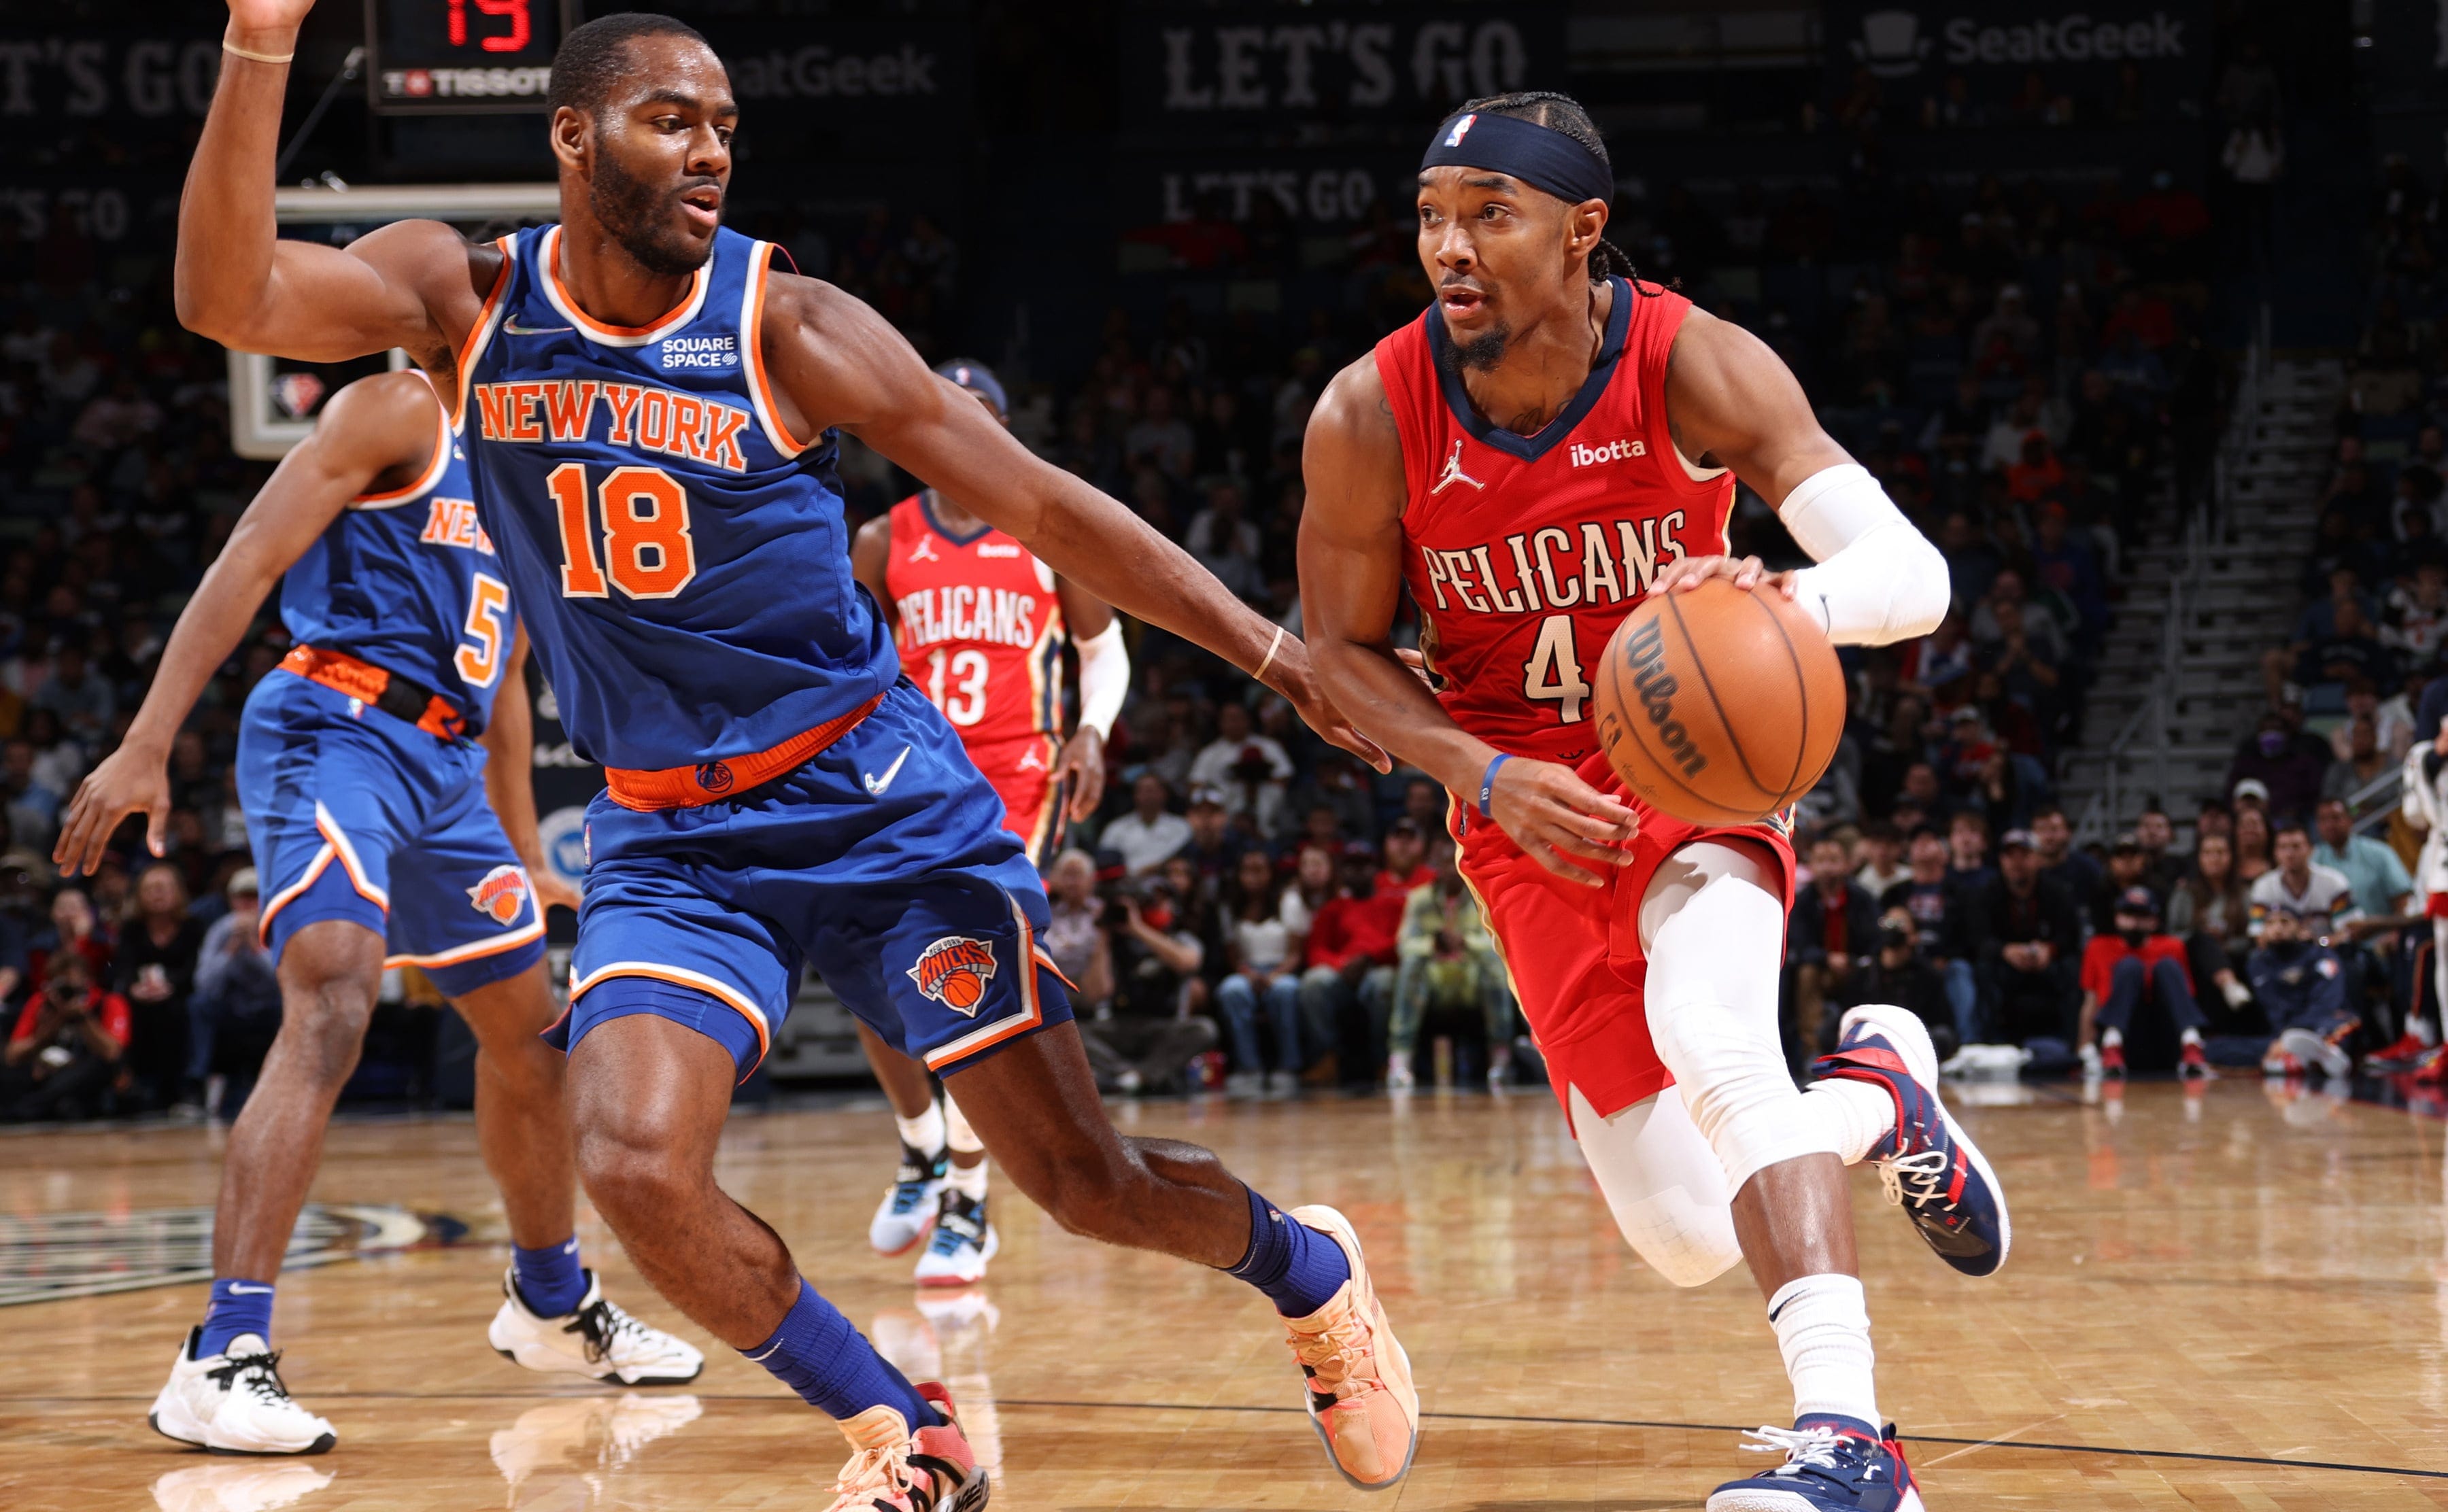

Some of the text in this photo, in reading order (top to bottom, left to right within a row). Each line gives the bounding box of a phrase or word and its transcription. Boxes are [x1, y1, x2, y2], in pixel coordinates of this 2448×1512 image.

[725, 41, 939, 99] atGeek
[1163, 19, 1527, 110] LET'S GO
[1943, 12, 2186, 65] SeatGeek
[431, 67, 552, 97] TISSOT
[1307, 168, 1378, 224] GO
[662, 336, 734, 353] SQUARE
[662, 352, 721, 368] SPACE
[474, 379, 751, 474] NEW YORK
[1569, 439, 1646, 468] ibotta
[546, 462, 697, 600] 18
[1421, 509, 1686, 614] PELICANS
[453, 571, 511, 689] 5
[896, 585, 1036, 651] PELICANS
[927, 647, 989, 726] 13
[1523, 613, 1591, 725] 4
[1625, 613, 1709, 780] Wilson
[920, 940, 995, 993] KNICKS
